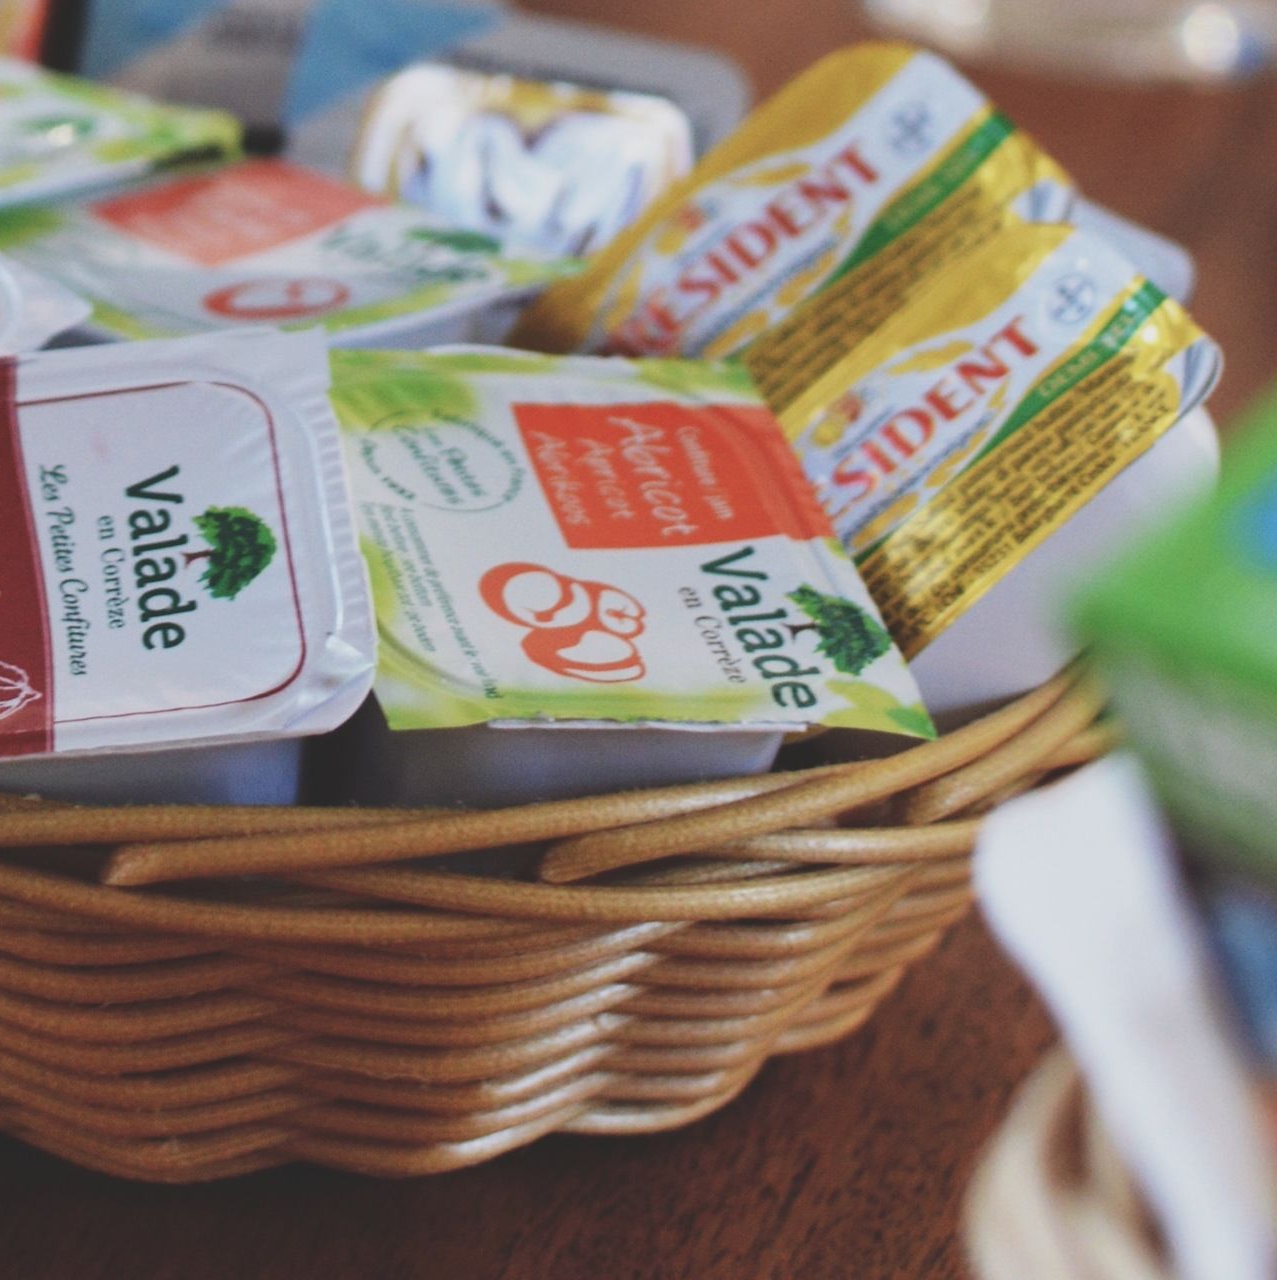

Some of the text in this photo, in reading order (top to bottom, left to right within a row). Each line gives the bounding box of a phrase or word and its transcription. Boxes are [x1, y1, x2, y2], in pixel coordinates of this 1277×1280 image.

[574, 438, 635, 520] Apricot
[607, 416, 700, 536] Abricot
[40, 464, 89, 676] Les Petites Confitures
[97, 515, 130, 630] en Corrèze
[125, 464, 197, 649] Valade
[678, 586, 747, 684] en Corrèze
[700, 546, 821, 709] Valade
